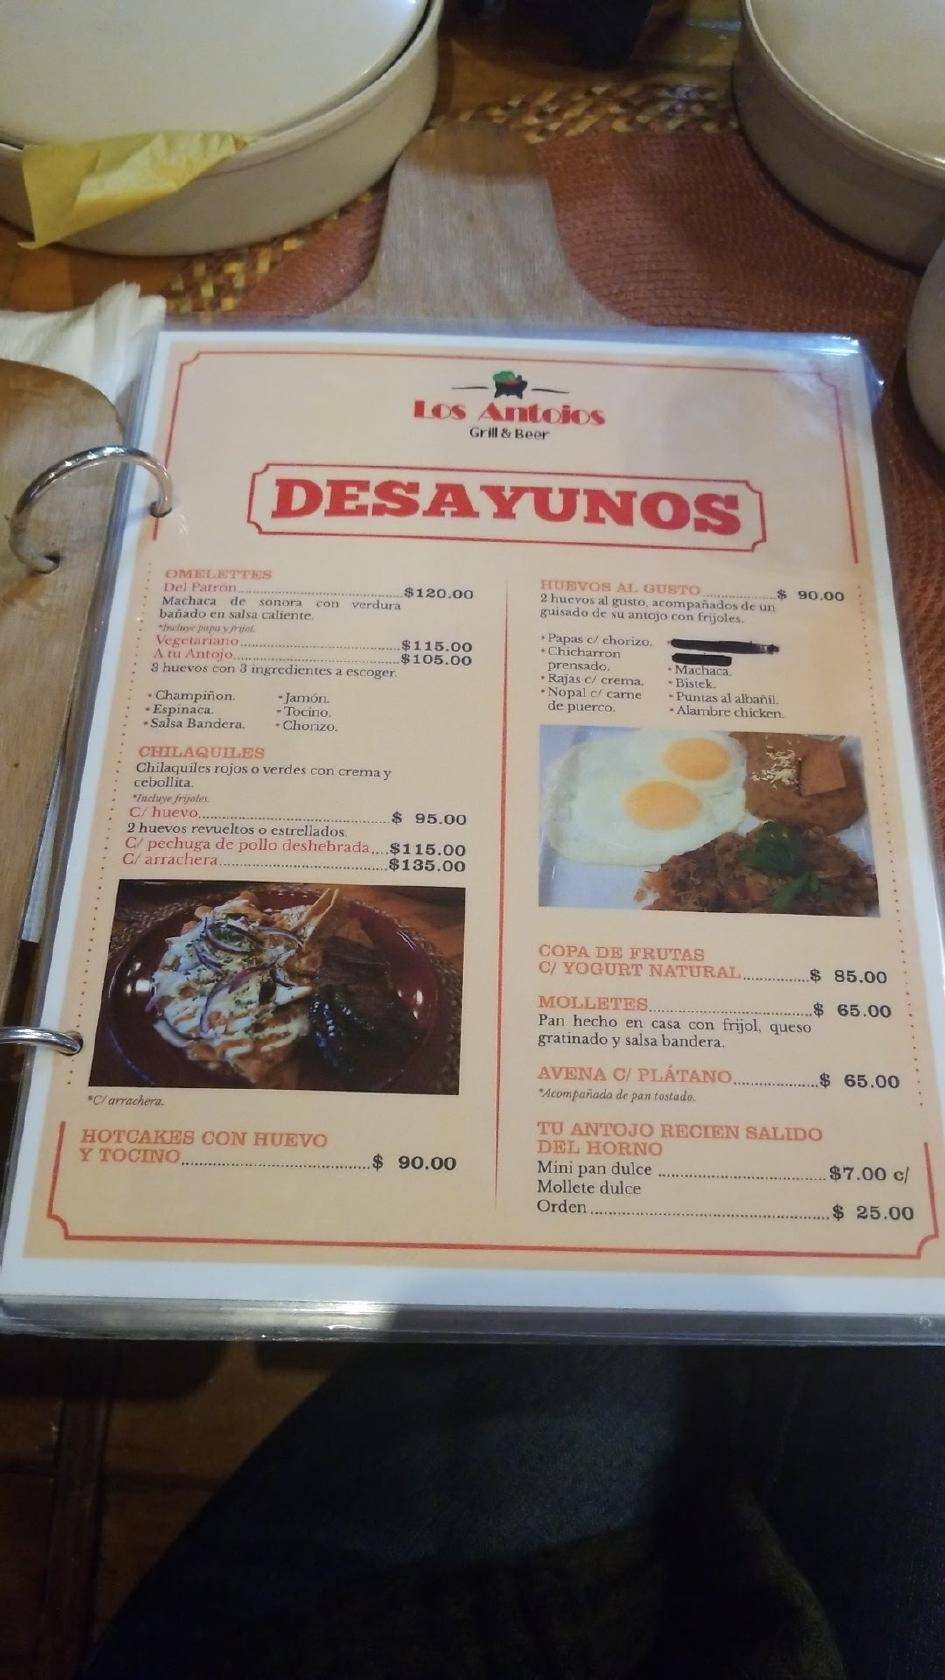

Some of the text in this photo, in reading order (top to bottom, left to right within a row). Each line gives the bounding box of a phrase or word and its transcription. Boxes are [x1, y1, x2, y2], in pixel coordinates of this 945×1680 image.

[414, 400, 606, 426] Los Antojos
[470, 427, 550, 440] Grill & Beer
[271, 478, 741, 535] DESAYUNOS
[165, 569, 272, 580] OMELETTES
[164, 582, 474, 599] Del $120.00
[541, 580, 845, 601] HUEVOS AL GUSTO $ 90.00
[161, 597, 401, 611] Machaca de sonora con verdura
[541, 593, 776, 612] 2 huevos al acompañados de un
[159, 608, 206, 619] bañado
[228, 609, 258, 620] salsa
[262, 611, 314, 621] caliente.
[540, 607, 745, 625] guisado de su antojo con frijoles.
[155, 634, 473, 653] Vegetariano $115.00
[548, 634, 652, 647] Papas c/ chorizo.
[152, 649, 472, 666] A tu Antojo $105.00
[548, 647, 621, 658] Chicharron
[163, 663, 397, 679] huevos con ingredientes a escoger.
[548, 661, 610, 673] prensado.
[548, 674, 644, 686] Rajas c/ crema.
[676, 678, 717, 689] Bistek.
[548, 688, 642, 700] Nopal c/ carne
[676, 692, 732, 703] Puntas al
[152, 704, 214, 715] Espinaca.
[284, 706, 332, 718] Tocino.
[548, 701, 616, 716] de puerco.
[676, 706, 785, 719] Alambre chicken.
[150, 717, 245, 729] Salsa Bandera.
[282, 720, 338, 732] Chorizo.
[138, 746, 265, 760] CHILAQUILES
[136, 762, 391, 780] Chilaquiles rojos o verdes con crema y
[134, 776, 194, 788] cebollita.
[129, 806, 467, 826] C/ huevo $ 95.00
[127, 823, 347, 838] 2 huevos revueltos o estrellados.
[125, 837, 466, 857] C/ pechuga de pollo deshebrada $115.00
[122, 853, 466, 873] C/ arrachera $135.00
[539, 944, 705, 961] COPA DE FRUTAS
[539, 961, 888, 984] C/ YOGURT NATURAL $ 85.00
[538, 995, 892, 1018] MOLLETES $ 65.00
[538, 1013, 812, 1036] Pan hecho en casa con queso
[537, 1032, 725, 1049] gratinado y salsa bandera.
[537, 1065, 901, 1090] AVENA C/ PLÁTANO $ 65.00
[108, 1094, 164, 1107] arrachera.
[616, 1090, 629, 1100] de
[631, 1091, 651, 1102] pan
[654, 1090, 696, 1102] tostado.
[80, 1129, 328, 1148] HOTCAKES CON HUEVO
[537, 1120, 823, 1142] TU ANTOJO RECIEN SALIDO
[537, 1139, 663, 1156] DEL HORNO
[80, 1148, 457, 1171] Y TOCINO $ 90.00
[537, 1160, 909, 1182] Mini pan dulce $7.00 c/
[537, 1179, 641, 1195] Mollete dulce
[537, 1199, 914, 1221] Orden $ 25.00
